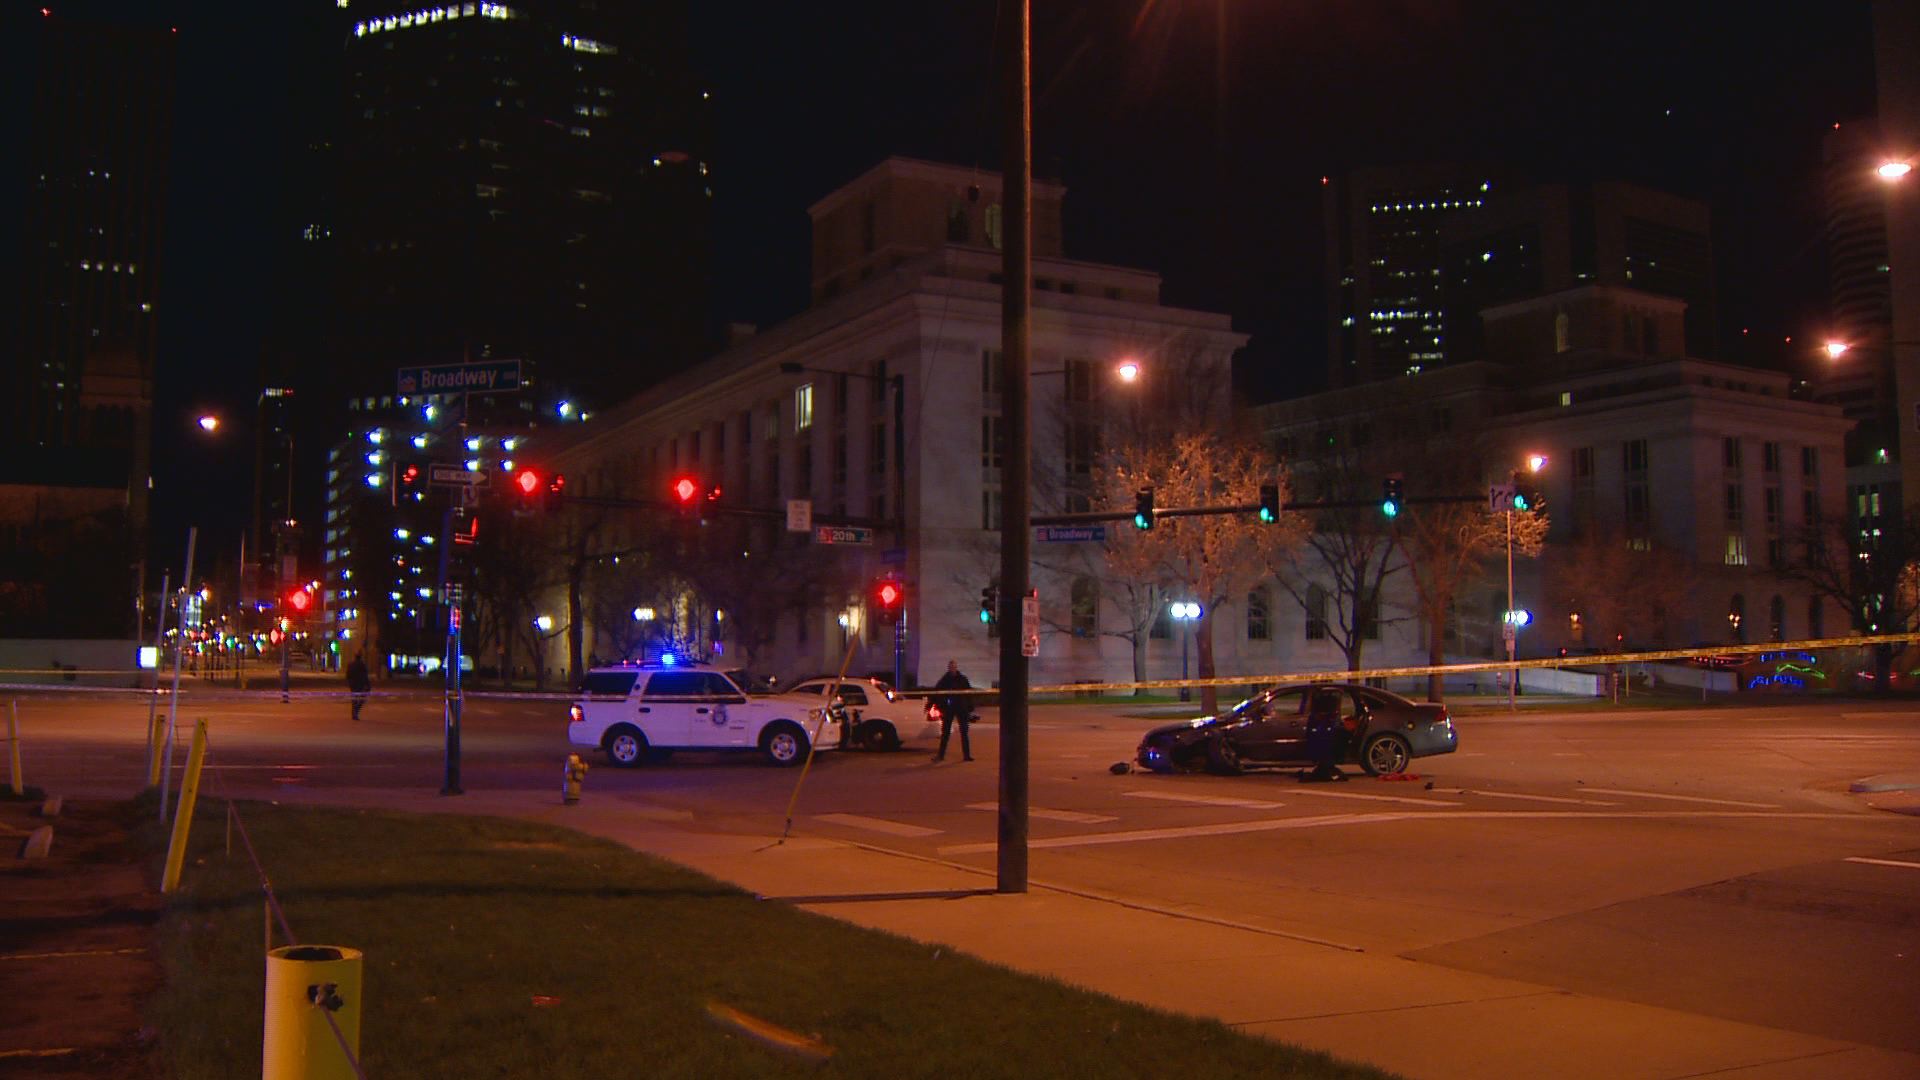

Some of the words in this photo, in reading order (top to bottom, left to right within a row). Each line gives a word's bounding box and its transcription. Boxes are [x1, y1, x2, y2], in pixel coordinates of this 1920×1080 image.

[421, 368, 497, 388] Broadway
[832, 529, 856, 541] 20th
[1049, 527, 1093, 540] Broadway
